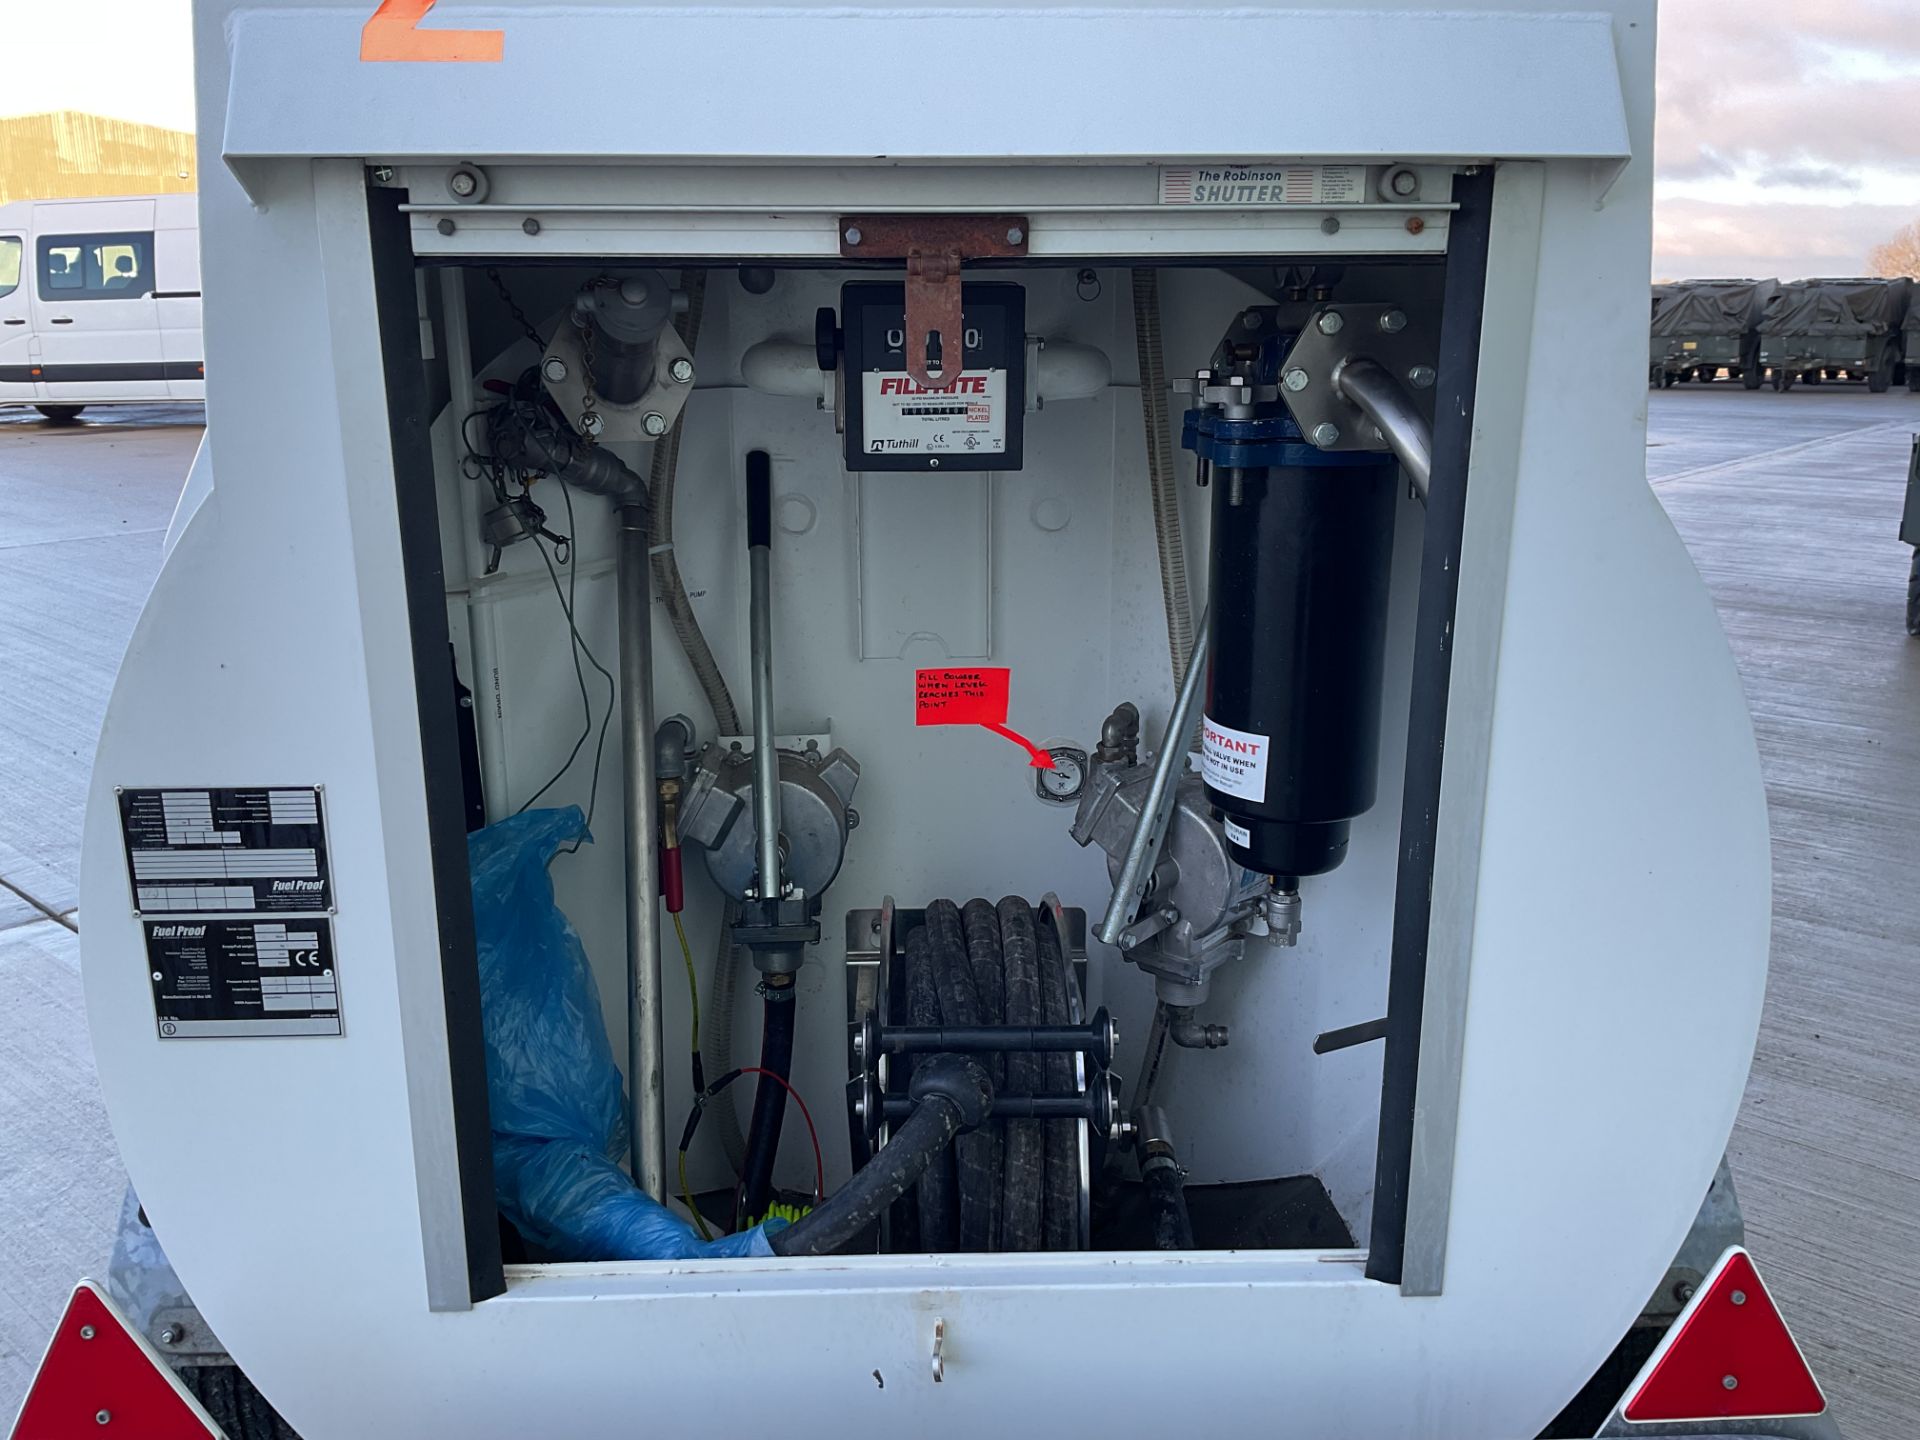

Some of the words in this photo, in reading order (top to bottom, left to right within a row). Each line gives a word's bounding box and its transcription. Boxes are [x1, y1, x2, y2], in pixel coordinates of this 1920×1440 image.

[1199, 171, 1220, 181] The
[1223, 170, 1282, 181] Robinson
[1194, 185, 1283, 202] SHUTTER
[965, 328, 979, 348] 0
[886, 439, 919, 449] Tuthill
[933, 434, 945, 442] CE
[690, 590, 707, 598] PUMP
[919, 672, 938, 680] FILL
[918, 701, 947, 709] POINT
[1213, 751, 1231, 763] VALVE
[1233, 757, 1256, 769] WHEN
[1210, 757, 1220, 768] NOT
[1221, 763, 1229, 771] IN
[1229, 766, 1245, 776] USE
[272, 880, 294, 891] Fuel
[295, 879, 325, 891] Proof
[152, 925, 176, 937] Fuel
[176, 925, 206, 936] Proof
[295, 950, 320, 967] CE
